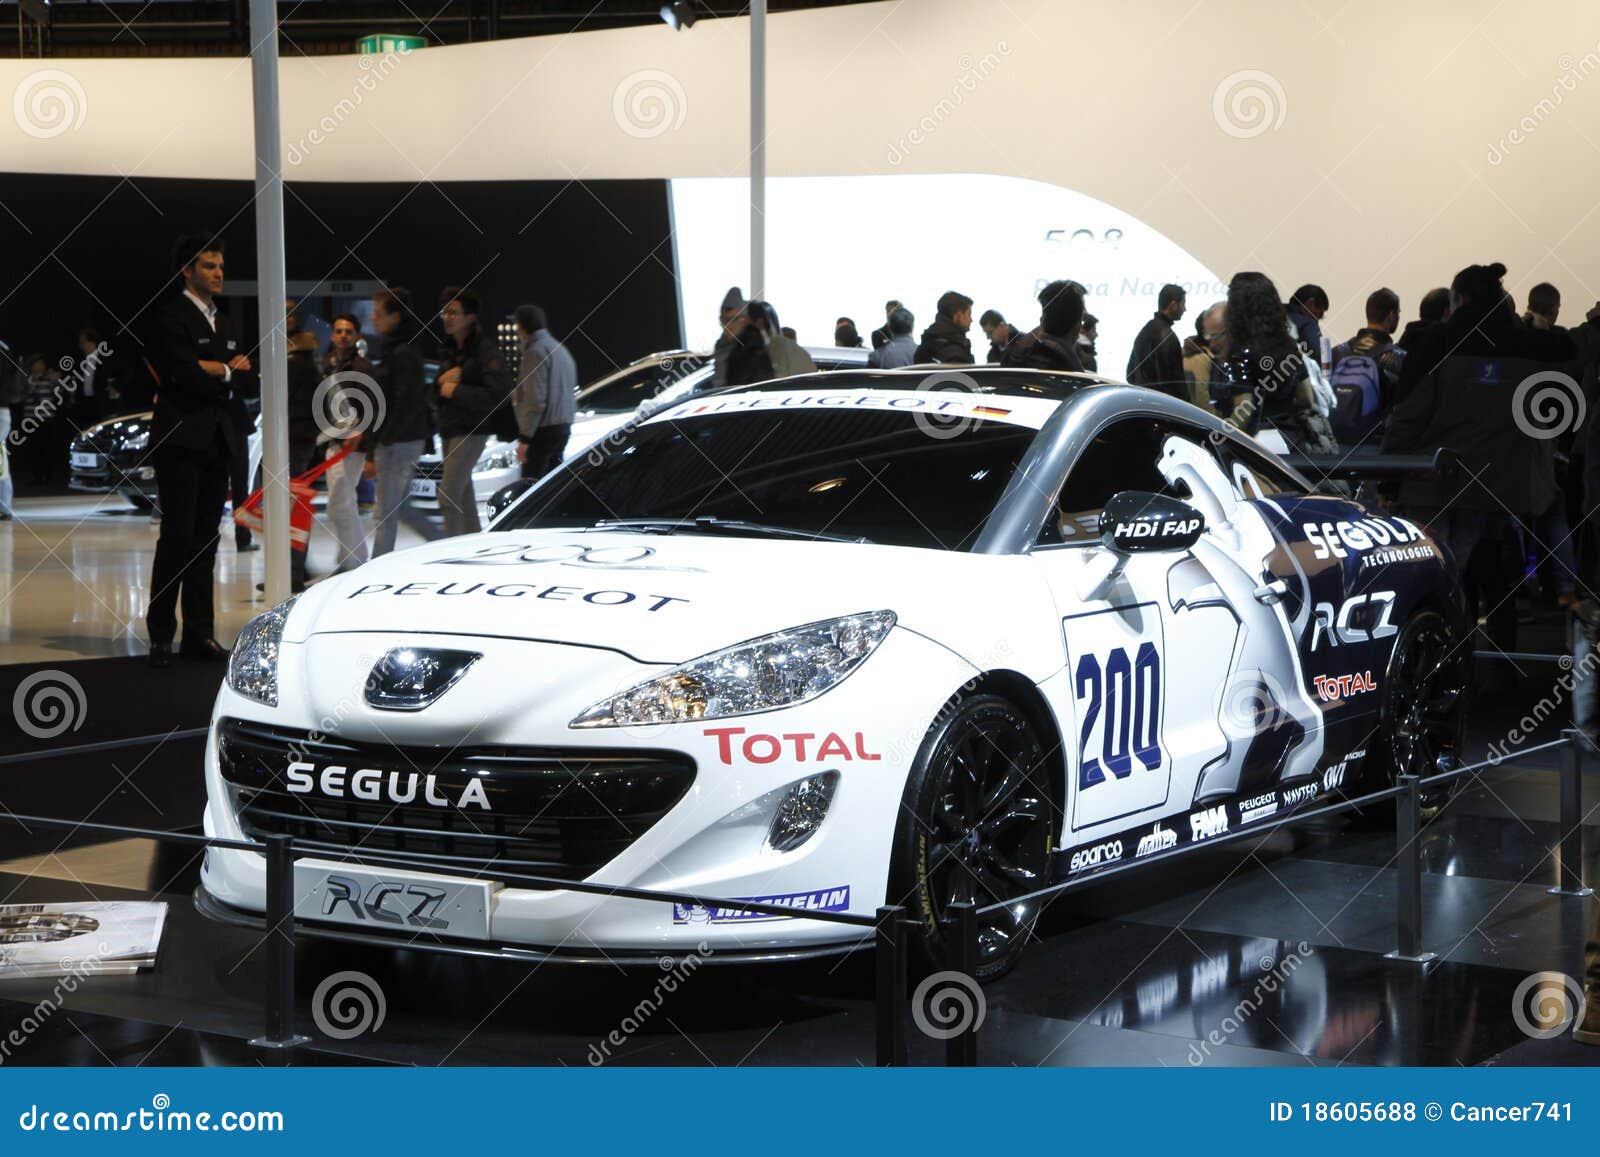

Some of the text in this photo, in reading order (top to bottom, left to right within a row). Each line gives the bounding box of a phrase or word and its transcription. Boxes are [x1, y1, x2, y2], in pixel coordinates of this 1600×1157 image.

[715, 396, 965, 412] PEUGEOT
[1161, 518, 1201, 537] FAP
[1302, 516, 1427, 560] SEGULA
[1361, 545, 1434, 568] TECHNOLOGIES
[346, 582, 690, 612] PEUGEOT
[1311, 590, 1400, 652] RCZ
[1313, 670, 1377, 702] TOTAL
[1075, 641, 1162, 792] 200
[703, 726, 882, 766] TOTAL
[286, 761, 493, 811] SEGULA
[1239, 791, 1276, 812] PEUGEOT
[1070, 839, 1123, 872] sparco
[321, 874, 449, 930] RCZ
